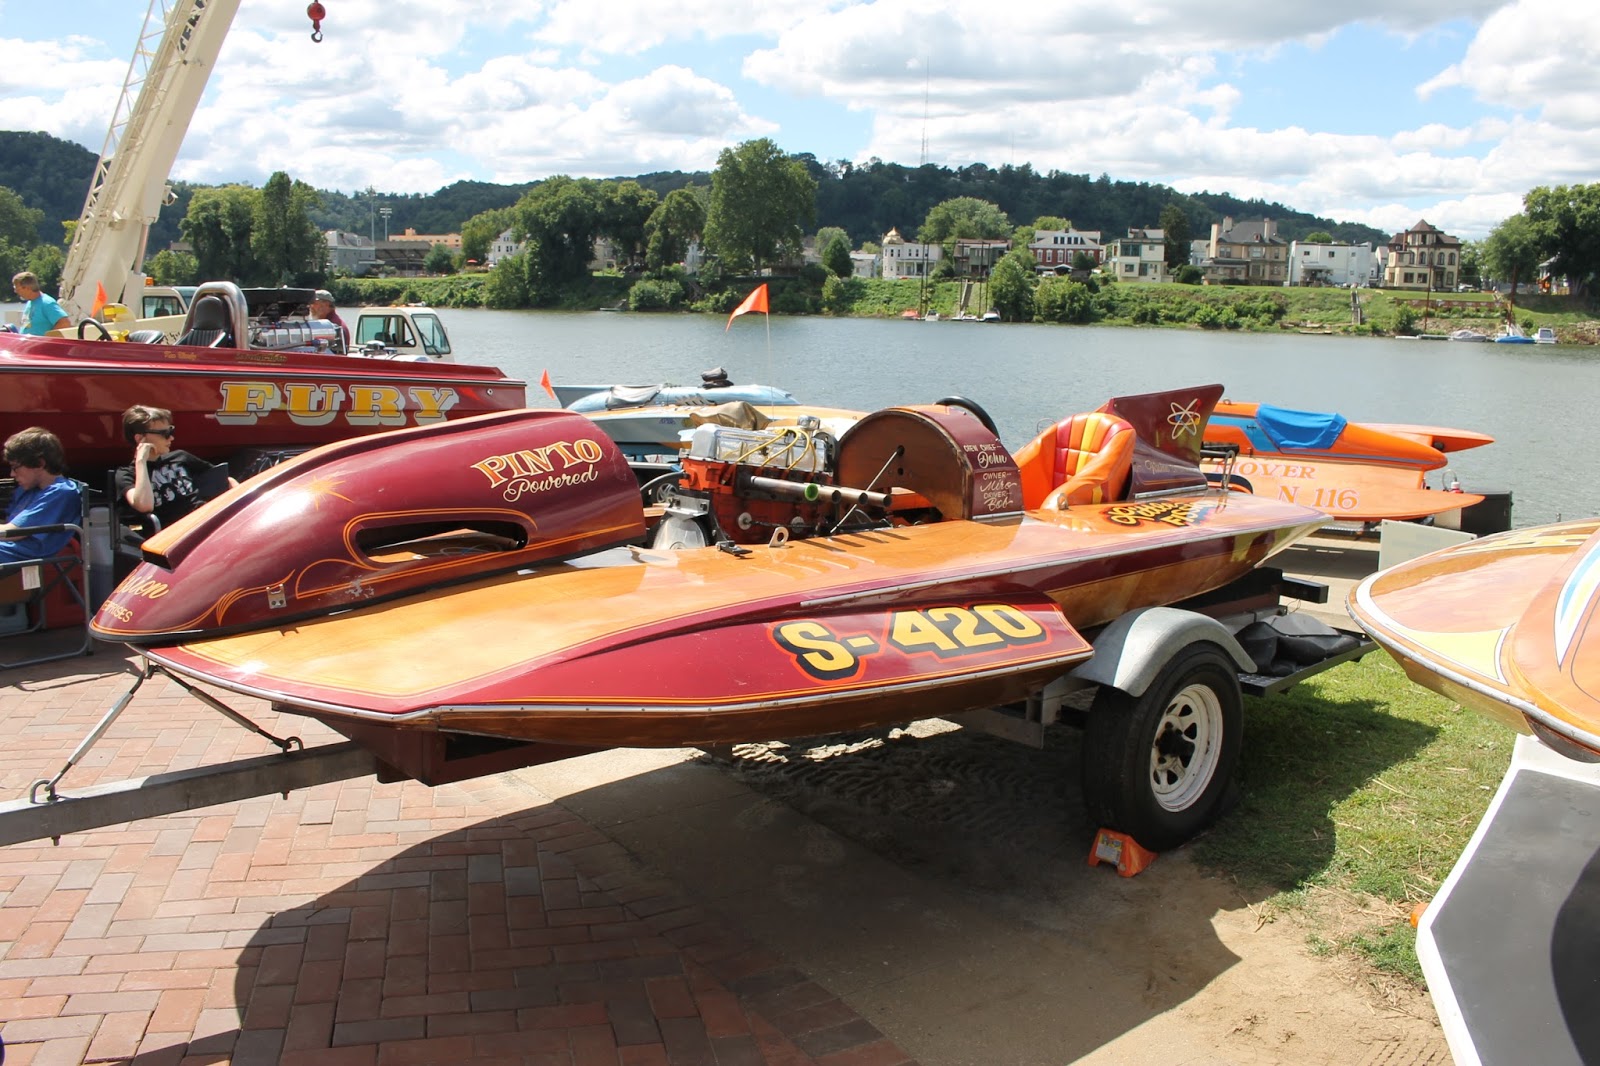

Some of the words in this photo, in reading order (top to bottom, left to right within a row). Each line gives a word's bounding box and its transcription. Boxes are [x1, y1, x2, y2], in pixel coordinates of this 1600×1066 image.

[215, 381, 460, 426] FURY
[470, 438, 603, 489] PINTO
[503, 464, 599, 502] Powered
[1278, 484, 1300, 505] N
[1312, 486, 1360, 511] 116
[984, 497, 1014, 511] Bob
